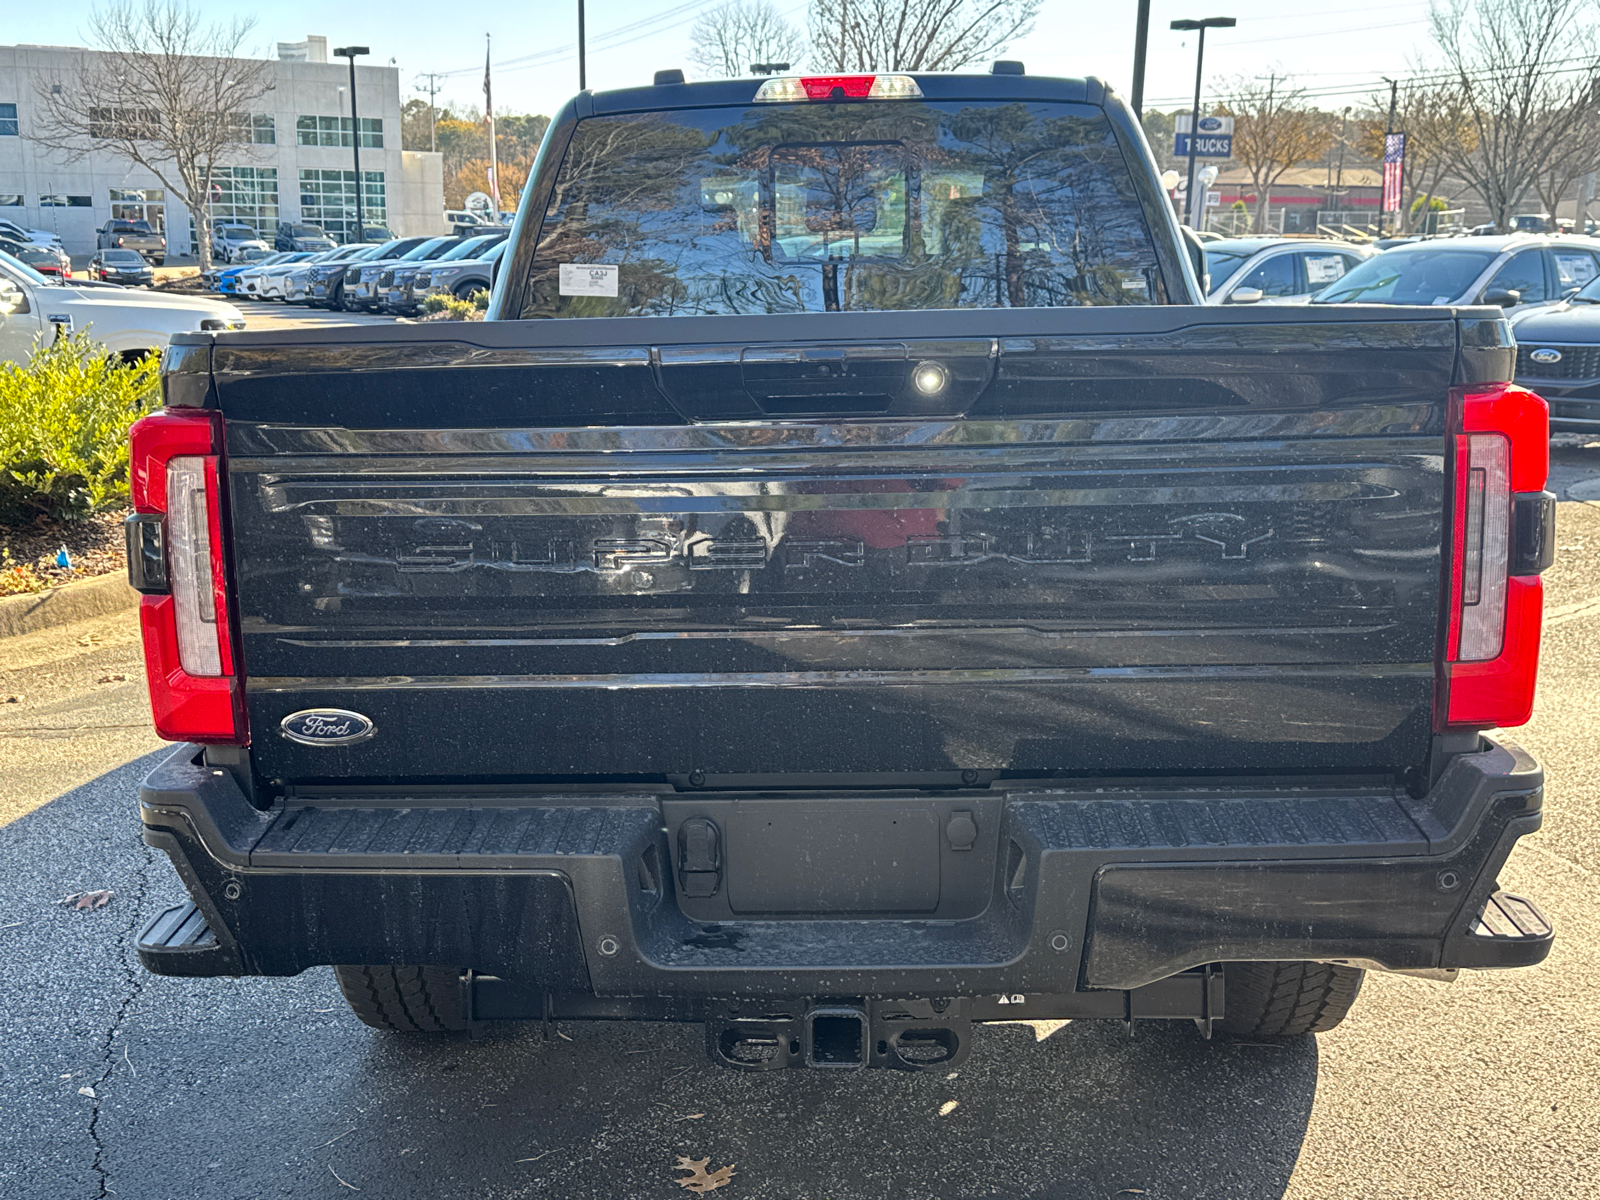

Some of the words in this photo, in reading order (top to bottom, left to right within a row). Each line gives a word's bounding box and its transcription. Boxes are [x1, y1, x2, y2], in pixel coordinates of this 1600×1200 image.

[397, 537, 866, 574] SUPER
[905, 528, 1276, 565] DUTY
[301, 715, 350, 735] Ford
